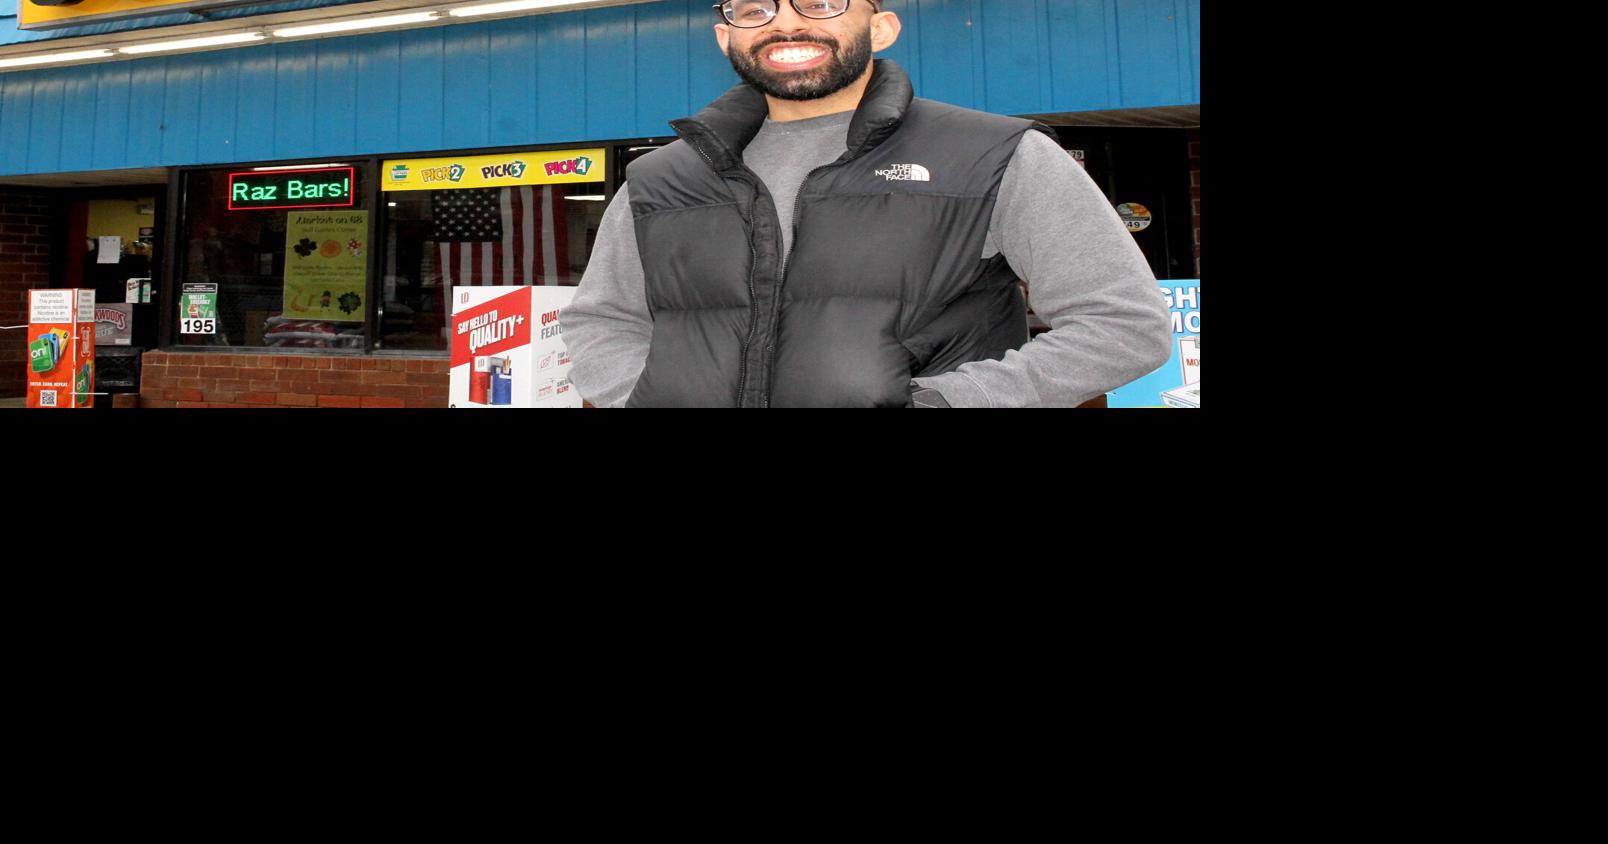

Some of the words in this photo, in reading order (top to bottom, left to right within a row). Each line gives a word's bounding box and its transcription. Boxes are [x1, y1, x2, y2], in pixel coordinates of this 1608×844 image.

[232, 182, 277, 201] Raz
[287, 177, 349, 199] Bars!
[1160, 286, 1200, 309] GH
[184, 319, 214, 333] 195
[457, 320, 470, 335] SAY
[469, 313, 489, 331] HELLO
[489, 309, 498, 323] TO
[541, 309, 560, 326] QUA
[1186, 358, 1200, 367] MO
